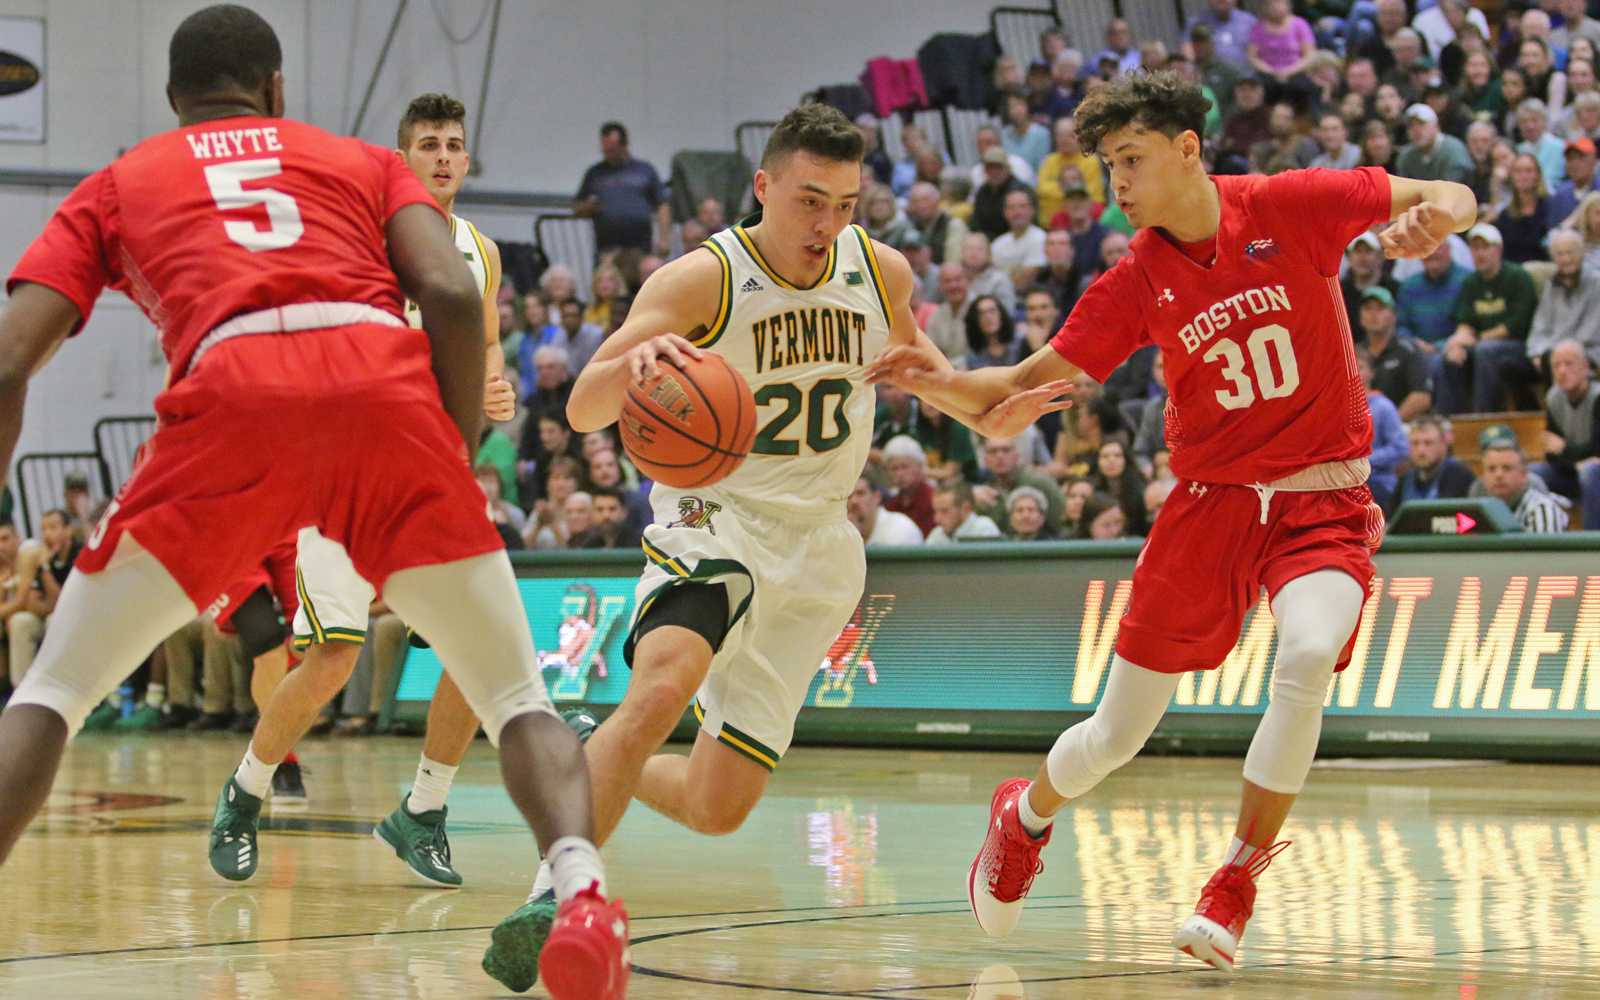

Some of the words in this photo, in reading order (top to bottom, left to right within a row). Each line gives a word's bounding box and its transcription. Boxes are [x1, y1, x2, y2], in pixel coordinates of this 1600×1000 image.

[186, 127, 283, 159] WHYTE
[204, 157, 305, 252] 5
[752, 307, 867, 375] VERMONT
[1178, 285, 1292, 354] BOSTON
[1202, 323, 1300, 411] 30
[750, 377, 854, 457] 20
